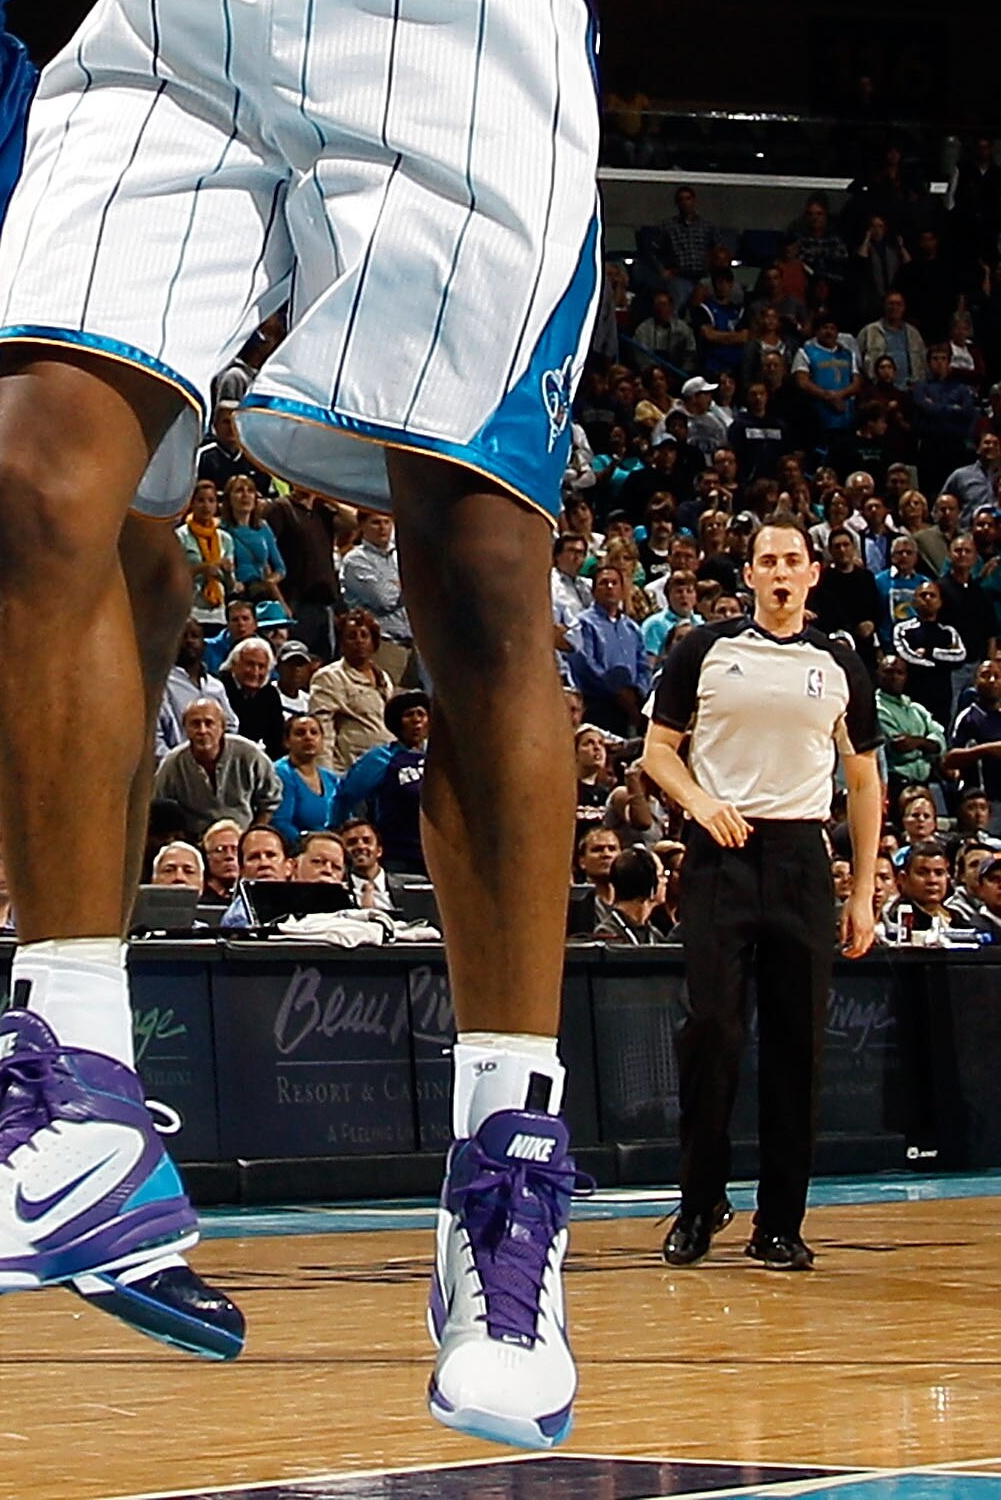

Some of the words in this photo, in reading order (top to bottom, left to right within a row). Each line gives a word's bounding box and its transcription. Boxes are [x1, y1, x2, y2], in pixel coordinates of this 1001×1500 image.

[274, 965, 386, 1054] Beau
[362, 1087, 375, 1102] &
[506, 1134, 555, 1162] NIKE
